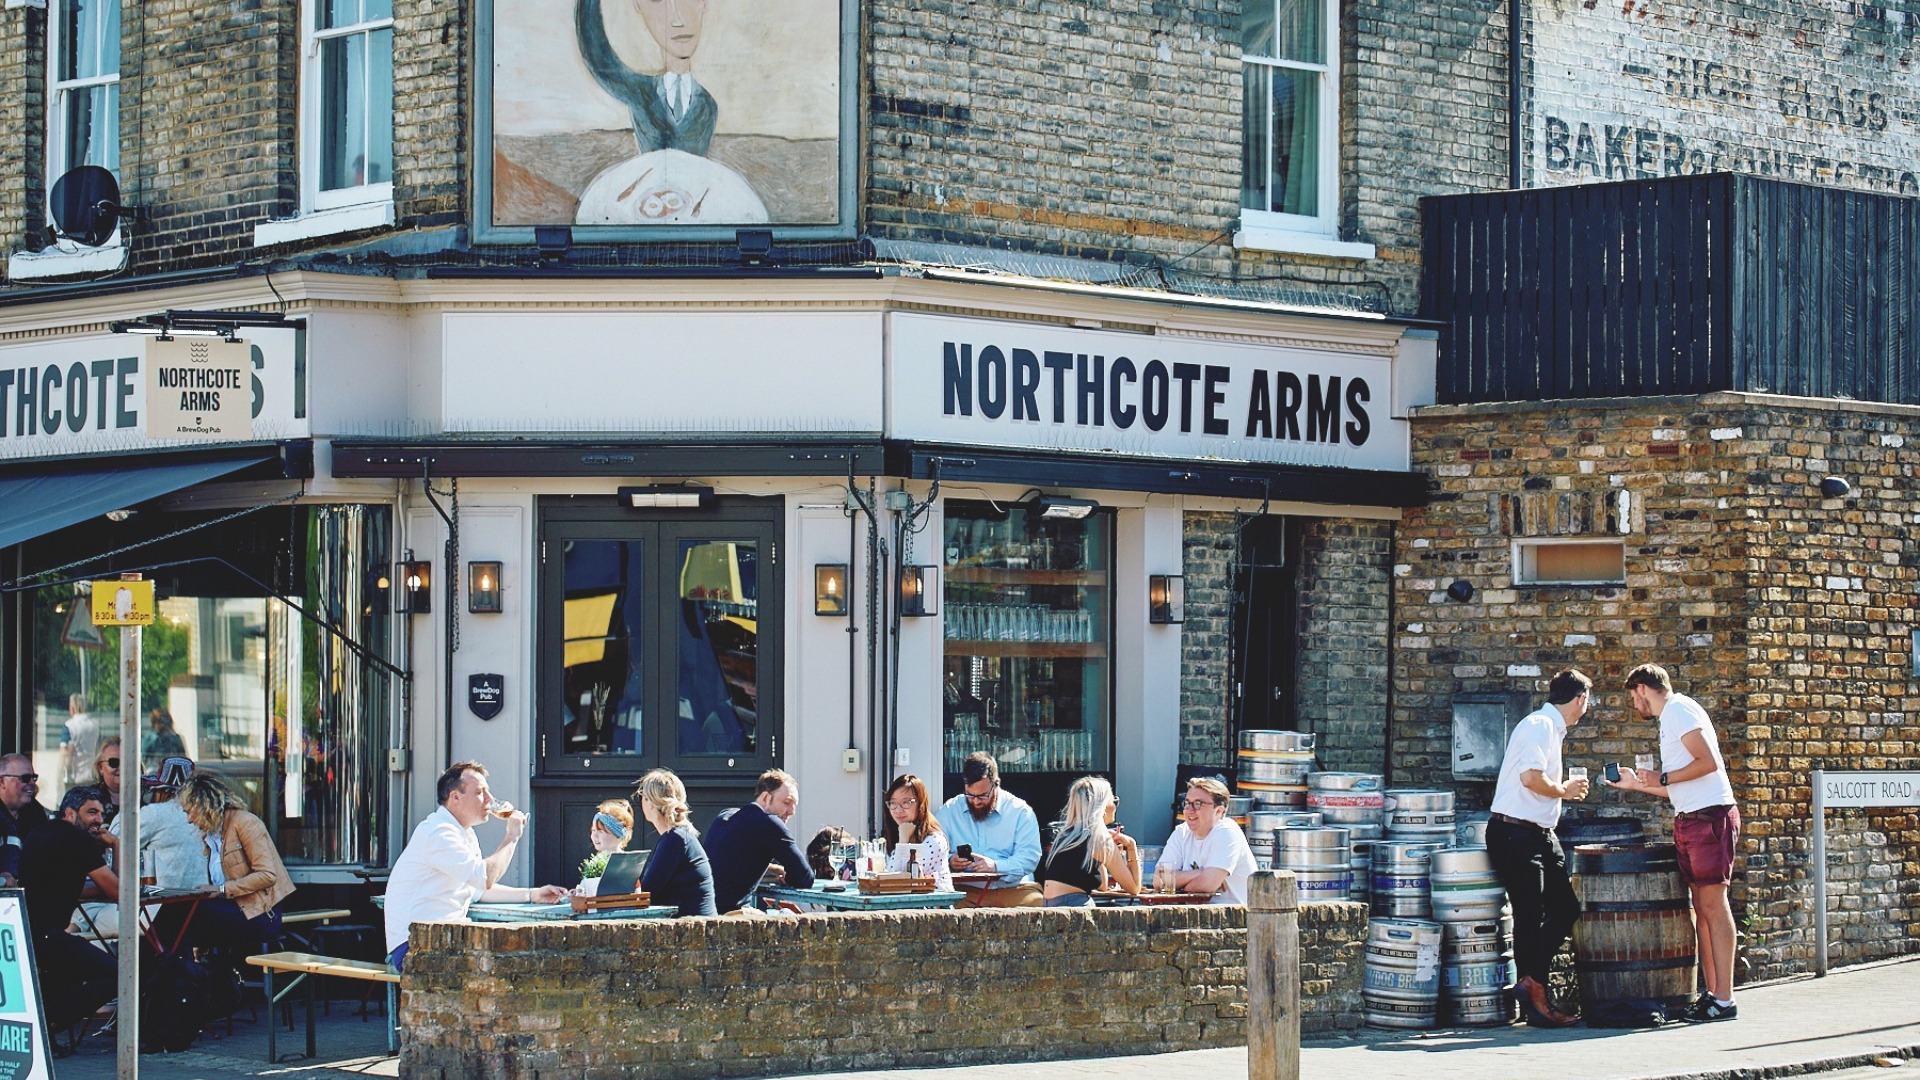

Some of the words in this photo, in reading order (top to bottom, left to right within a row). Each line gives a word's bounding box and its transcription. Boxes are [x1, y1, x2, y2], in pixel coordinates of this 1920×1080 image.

[159, 367, 241, 389] NORTHCOTE
[180, 391, 220, 411] ARMS
[943, 341, 1230, 436] NORTHCOTE
[1246, 369, 1371, 447] ARMS
[472, 687, 500, 695] BrewDog
[1826, 782, 1876, 799] SALCOTT
[1882, 781, 1912, 798] ROAD
[0, 1025, 30, 1053] ARE
[3, 1068, 15, 1076] THE
[5, 1061, 21, 1069] HALF
